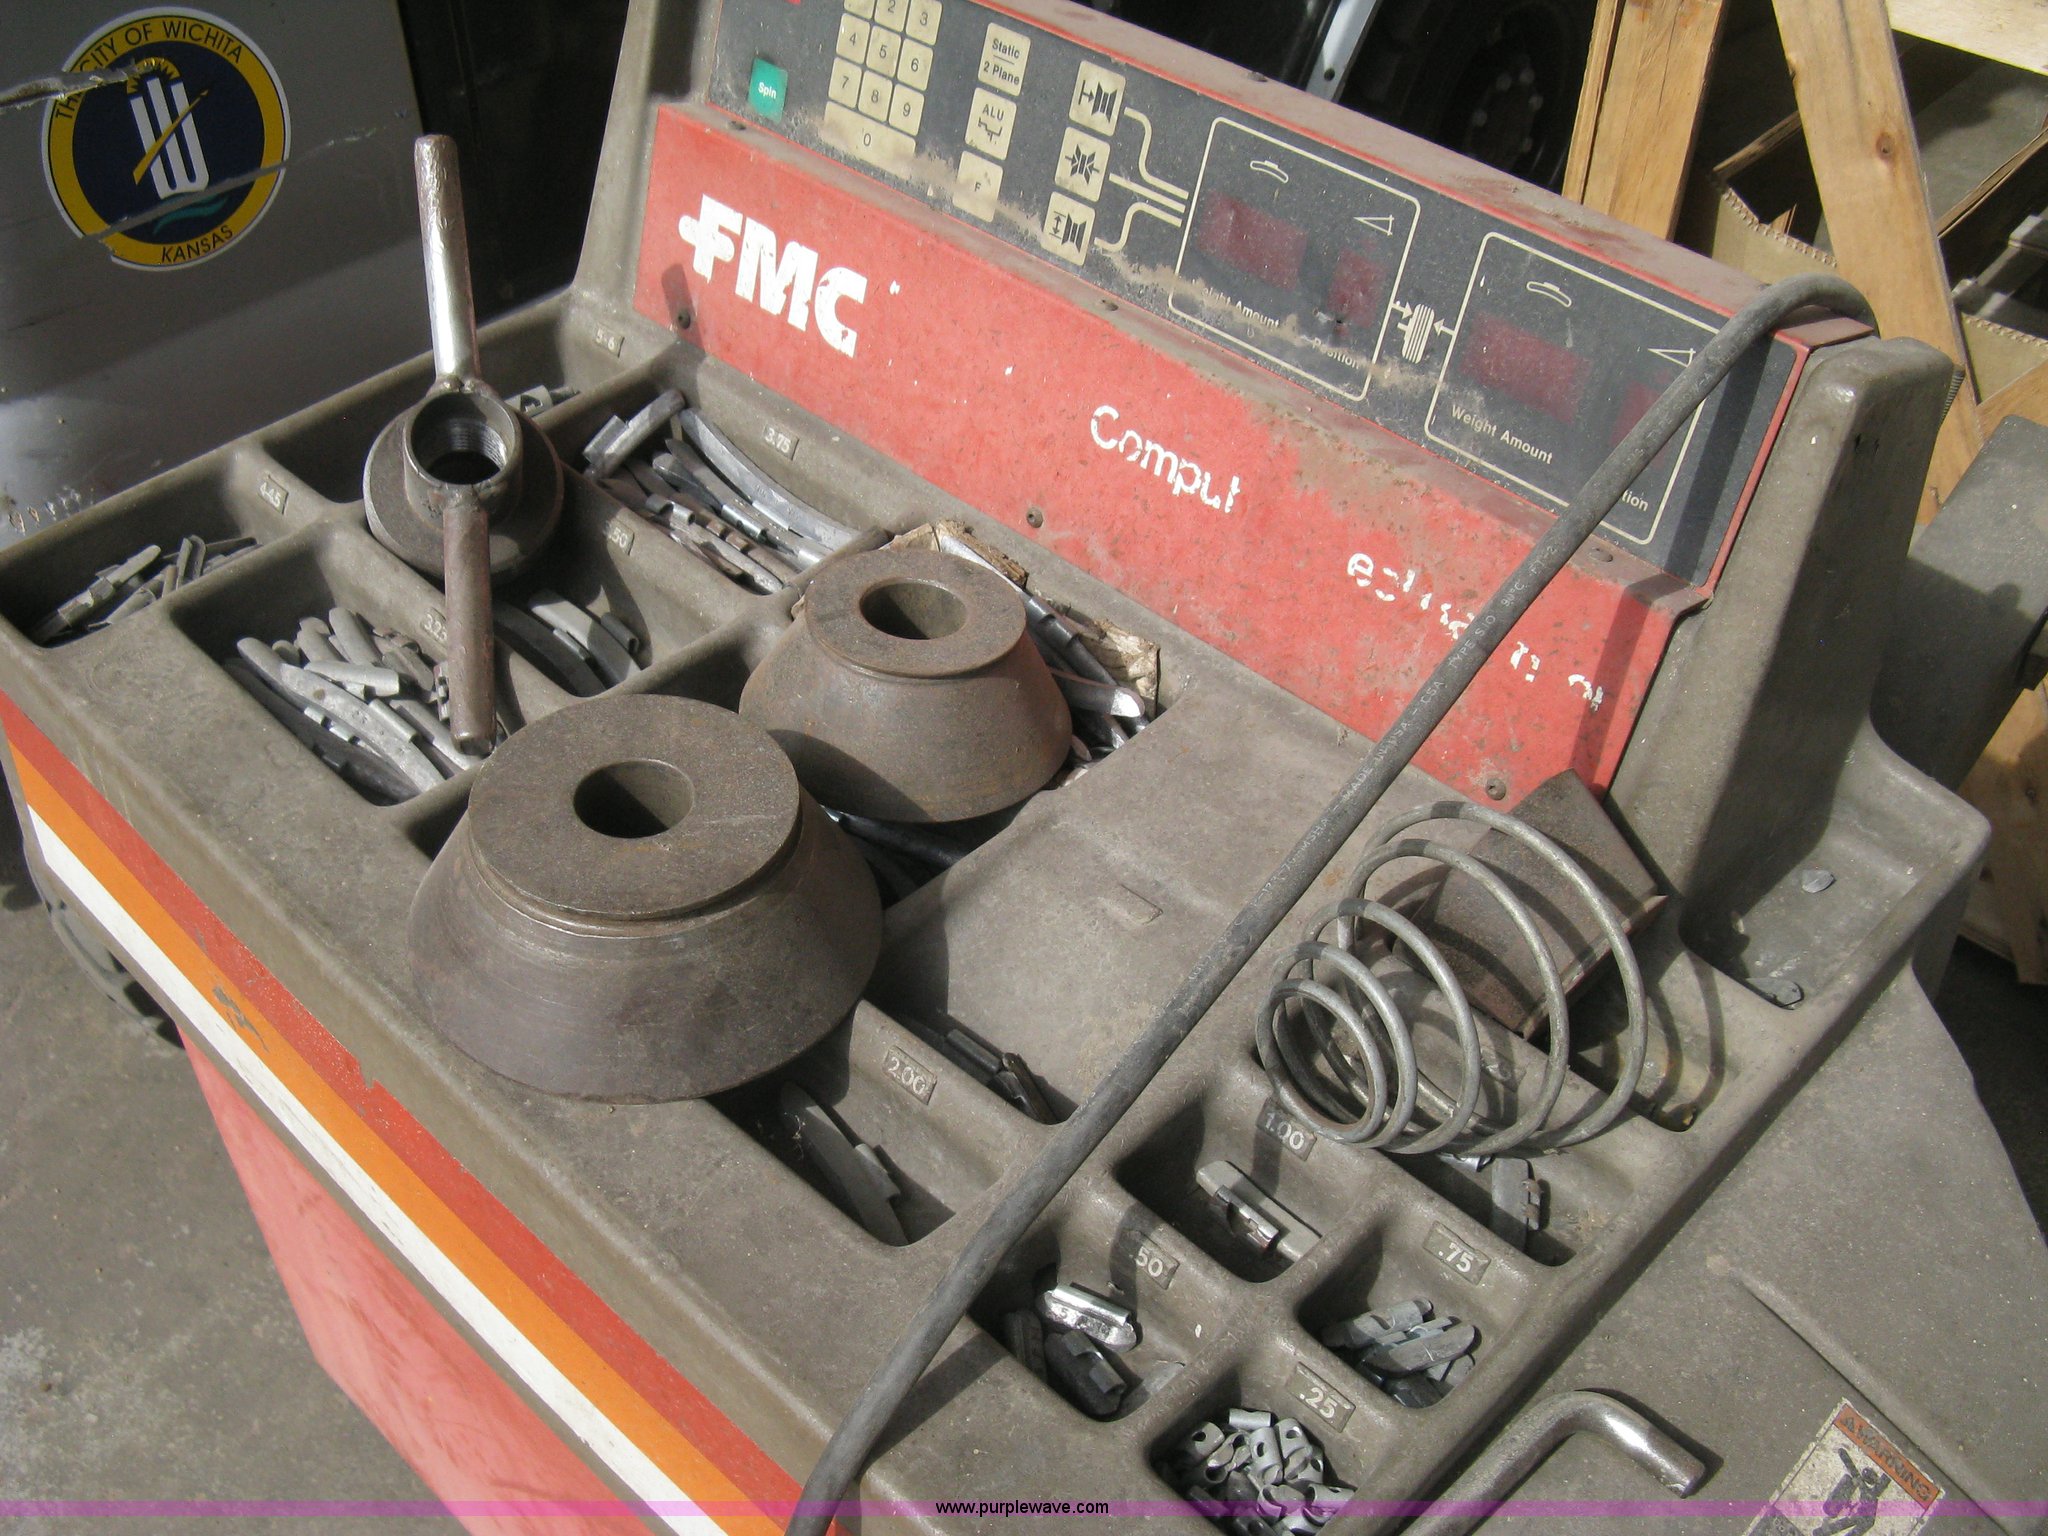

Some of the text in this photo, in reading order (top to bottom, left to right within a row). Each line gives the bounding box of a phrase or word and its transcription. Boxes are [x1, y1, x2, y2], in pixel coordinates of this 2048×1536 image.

[919, 12, 929, 26] 3
[79, 38, 118, 73] CITY
[125, 23, 153, 46] OF
[162, 20, 243, 63] WICHITA
[849, 33, 857, 46] 4
[991, 38, 1020, 59] Static
[878, 45, 887, 59] 5
[910, 58, 920, 72] 6
[983, 62, 1020, 85] 2 Plane
[758, 81, 777, 99] Spin
[841, 75, 849, 89] 7
[870, 89, 879, 104] 8
[902, 102, 911, 117] 9
[982, 103, 1005, 121] ALU
[863, 132, 872, 147] 0
[974, 181, 982, 193] F
[161, 225, 234, 264] KANSAS
[678, 193, 868, 358] FMC
[1235, 300, 1280, 328] Amount
[765, 427, 791, 453] 3.75
[1451, 404, 1554, 464] Weight Amount
[1448, 639, 1476, 669] TYPE
[887, 1056, 926, 1095] 2.00
[1265, 1112, 1305, 1150] 1.00
[1438, 1241, 1472, 1273] .75
[1299, 1386, 1336, 1419] .25
